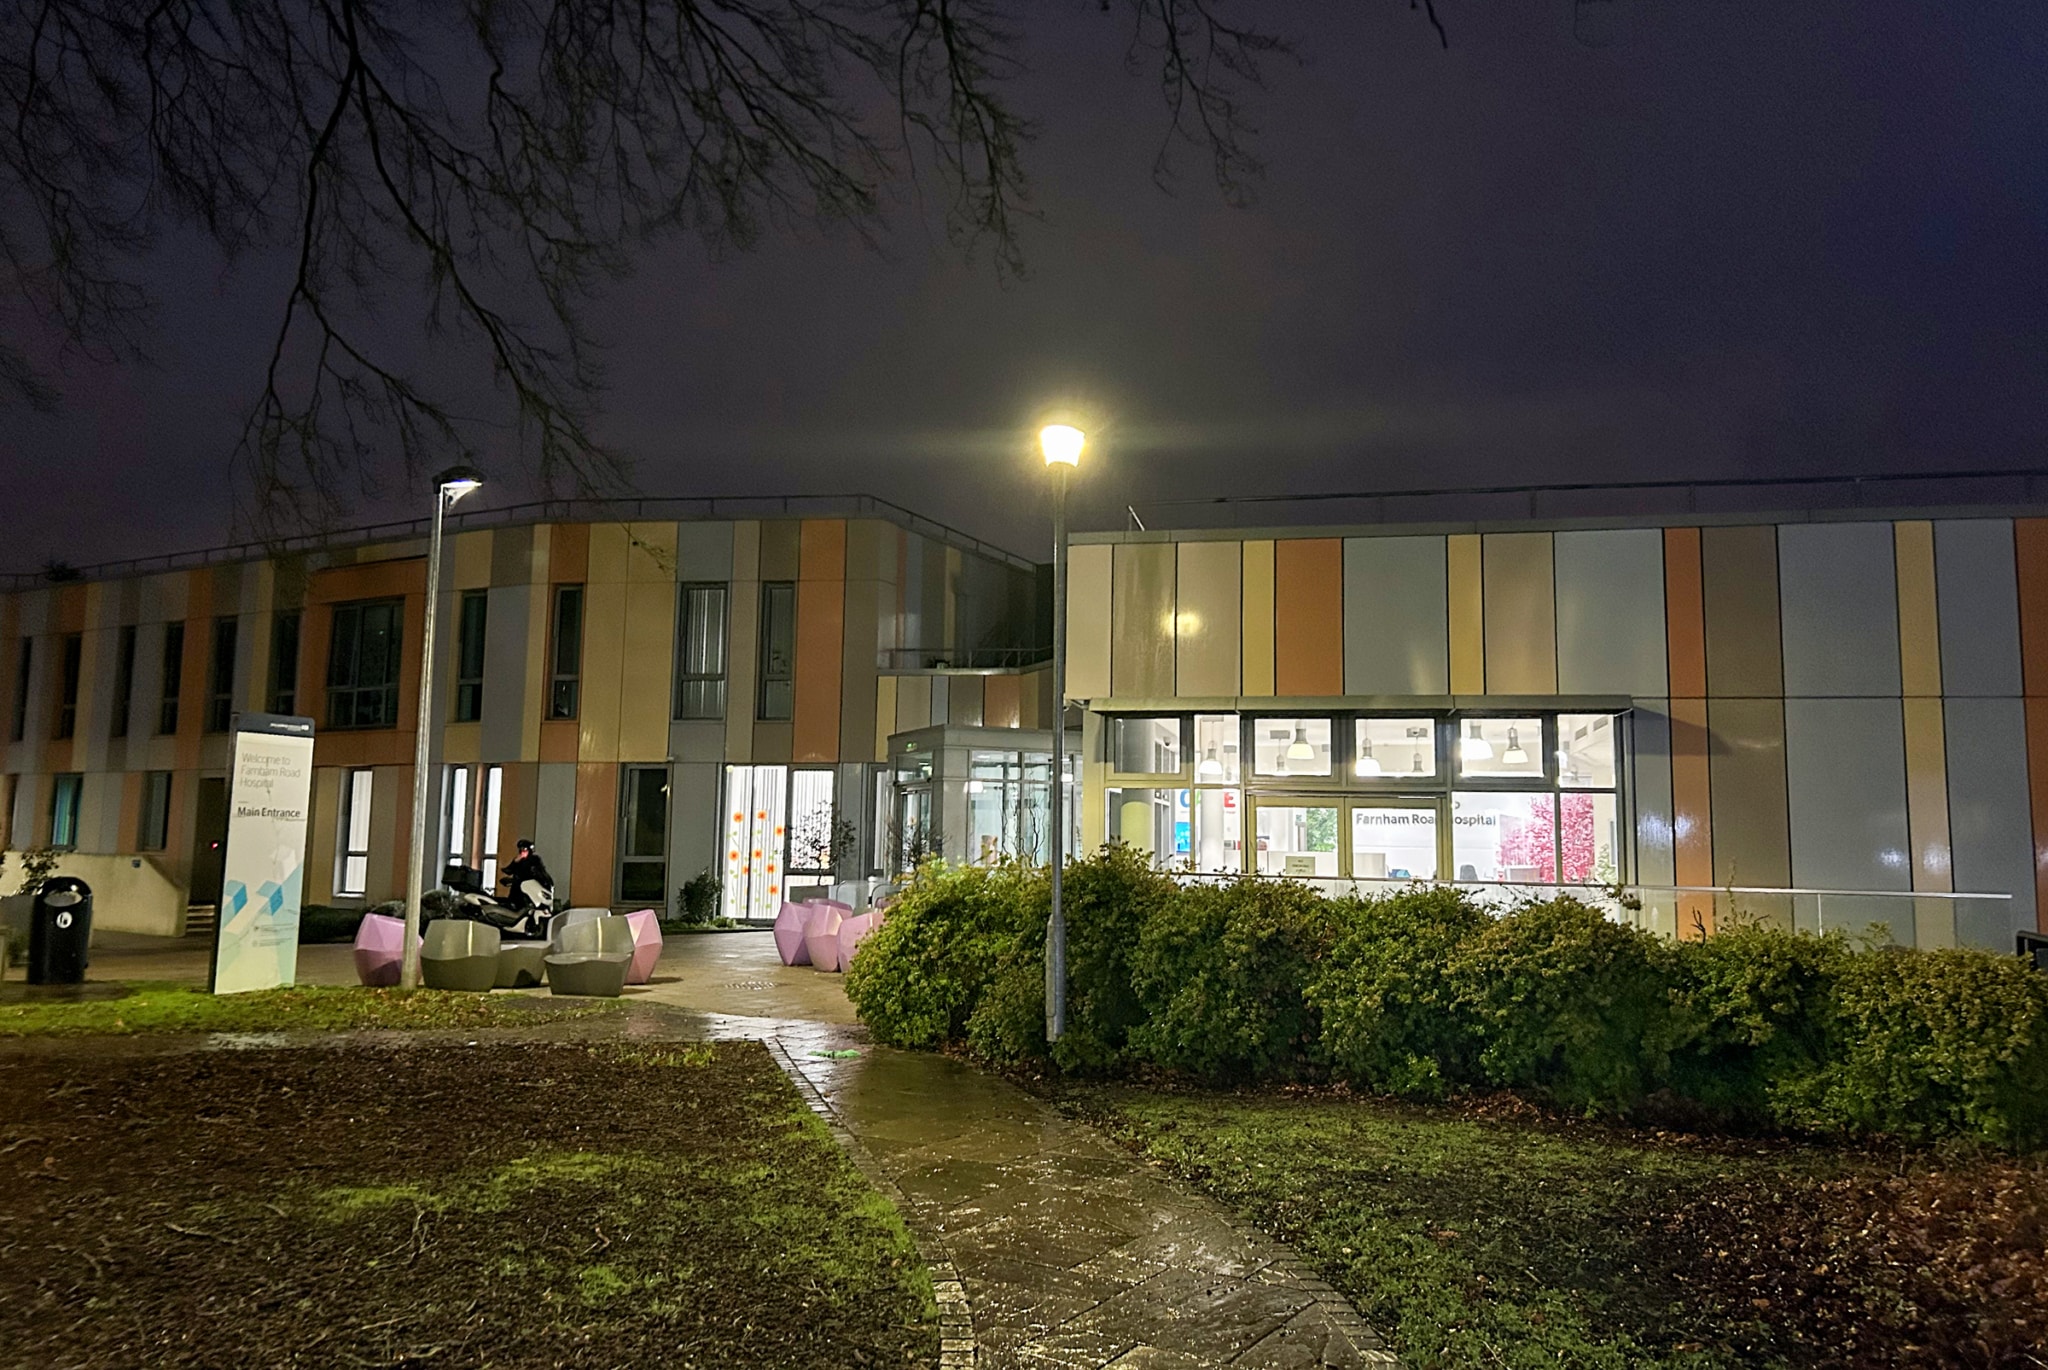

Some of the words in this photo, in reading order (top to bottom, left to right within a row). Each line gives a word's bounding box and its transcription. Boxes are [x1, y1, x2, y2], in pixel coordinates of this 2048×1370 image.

[241, 752, 281, 765] Welcome
[281, 755, 291, 766] to
[241, 764, 279, 777] Farnham
[279, 766, 301, 778] Road
[239, 777, 274, 789] Hospital
[237, 806, 260, 817] Main
[261, 807, 301, 818] Entrance
[1356, 813, 1410, 825] Farnham
[1411, 813, 1435, 825] Roa
[1454, 814, 1496, 827] ospital
